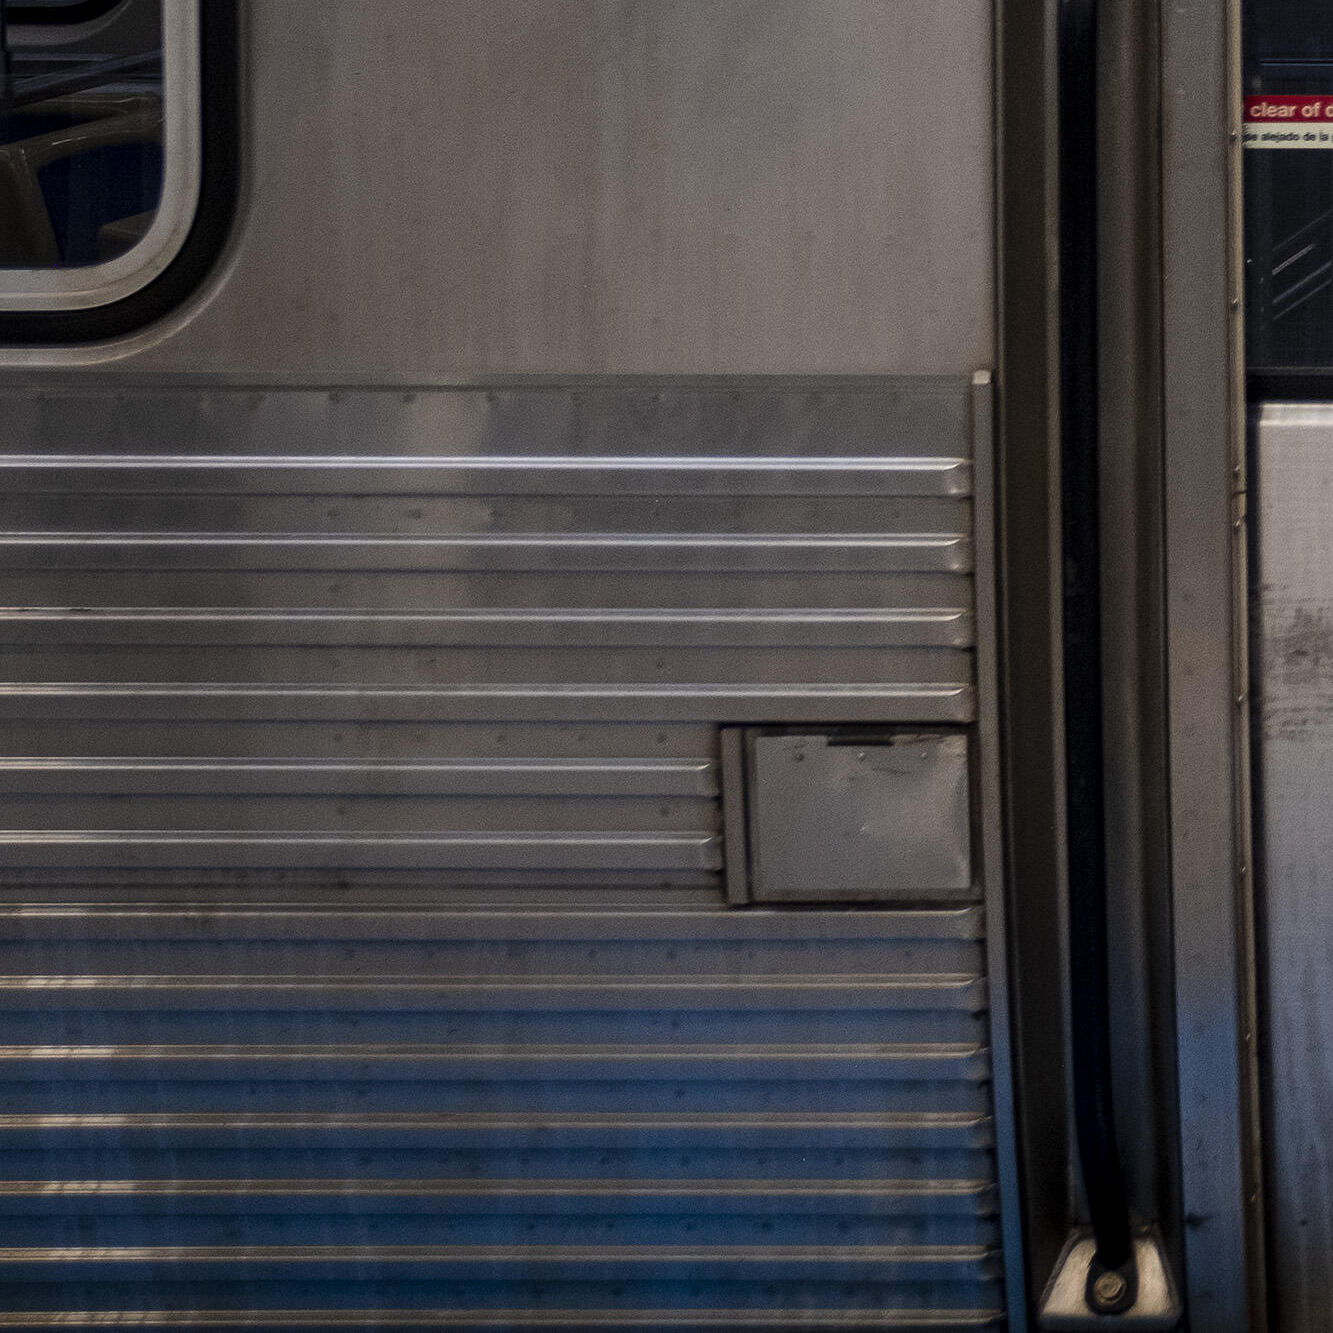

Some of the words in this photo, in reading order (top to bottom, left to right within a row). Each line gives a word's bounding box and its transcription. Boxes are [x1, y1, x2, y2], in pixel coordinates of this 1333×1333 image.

[1250, 102, 1297, 117] clear
[1301, 102, 1322, 117] of
[1261, 132, 1299, 143] alejado
[1303, 132, 1315, 141] de
[1319, 132, 1328, 141] la
